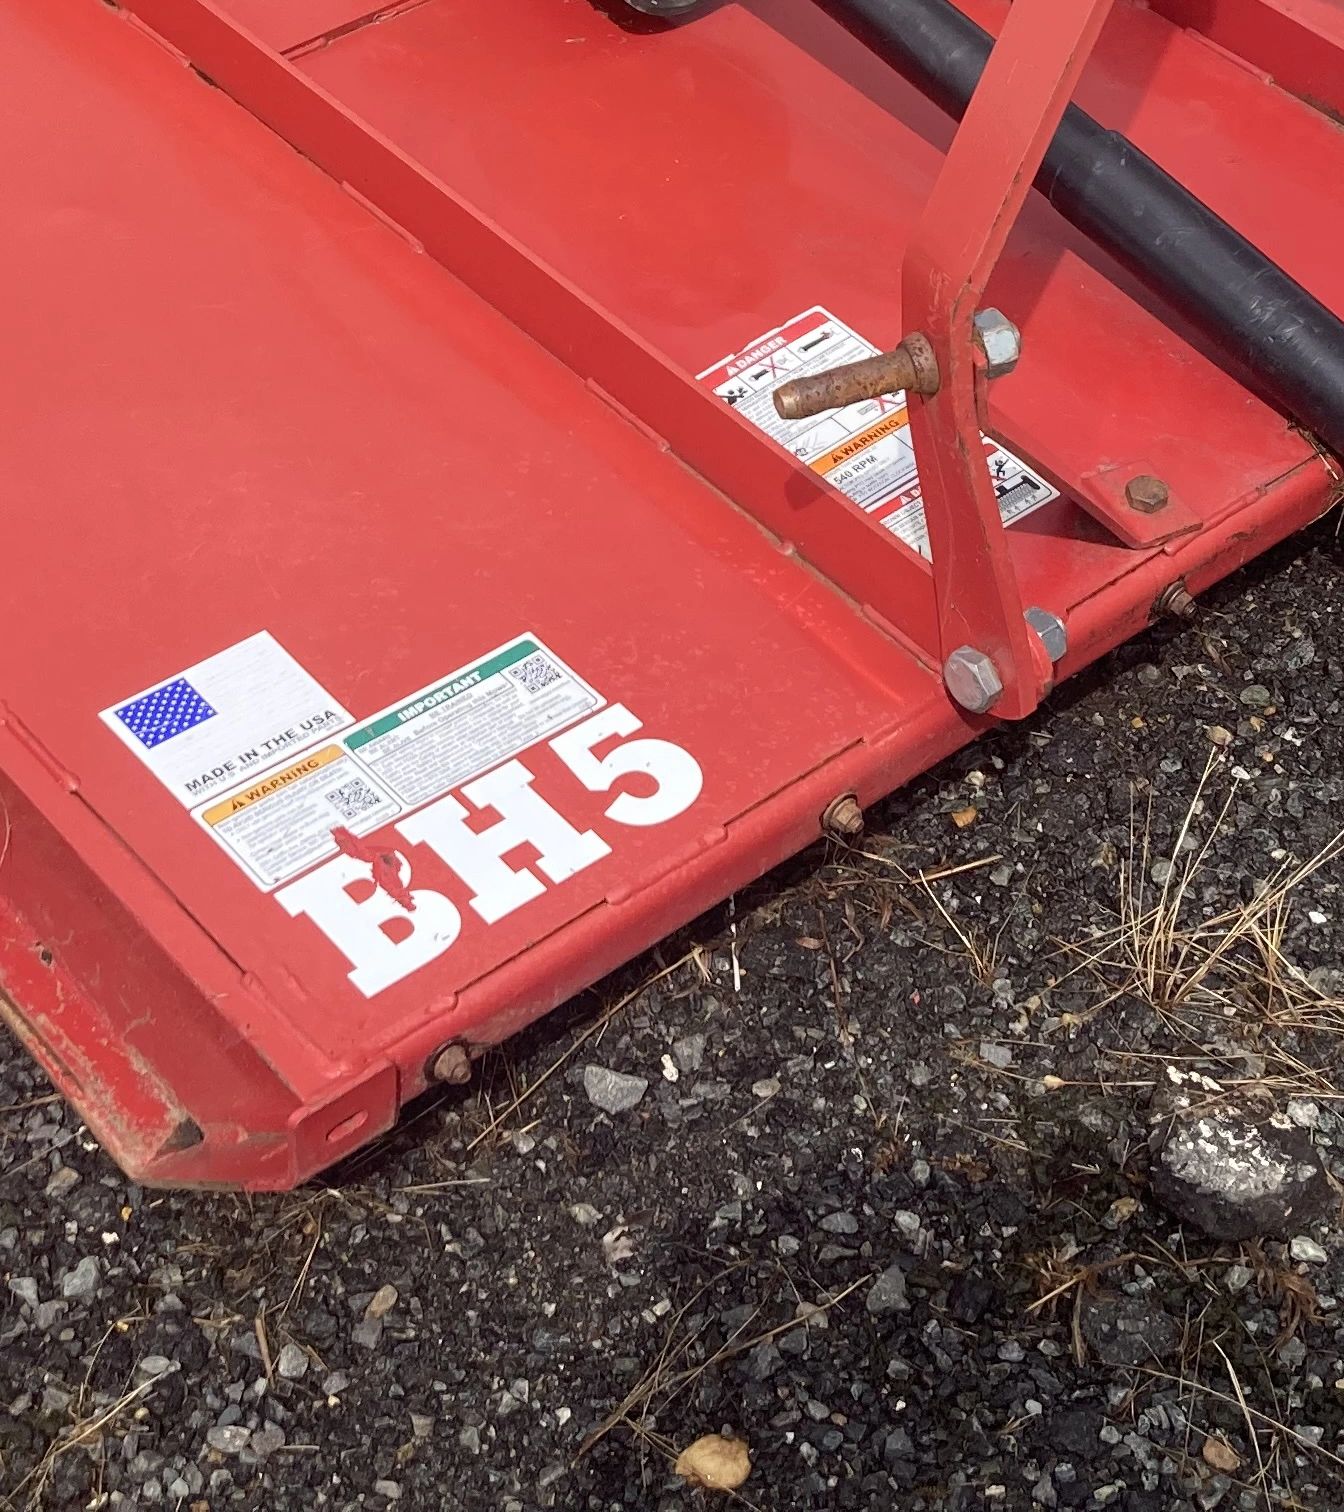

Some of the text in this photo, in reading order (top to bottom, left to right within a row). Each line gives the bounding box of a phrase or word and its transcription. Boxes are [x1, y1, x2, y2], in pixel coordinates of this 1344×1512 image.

[734, 335, 787, 369] DANGER
[840, 417, 899, 456] WARNING
[832, 469, 853, 484] 540
[851, 454, 878, 472] RPM
[396, 670, 485, 721] IMPORTANT
[183, 759, 237, 792] MADE
[236, 747, 259, 764] IN
[260, 727, 298, 752] THE
[298, 707, 336, 731] USA
[244, 758, 320, 801] WARNING
[274, 703, 703, 998] BH5
